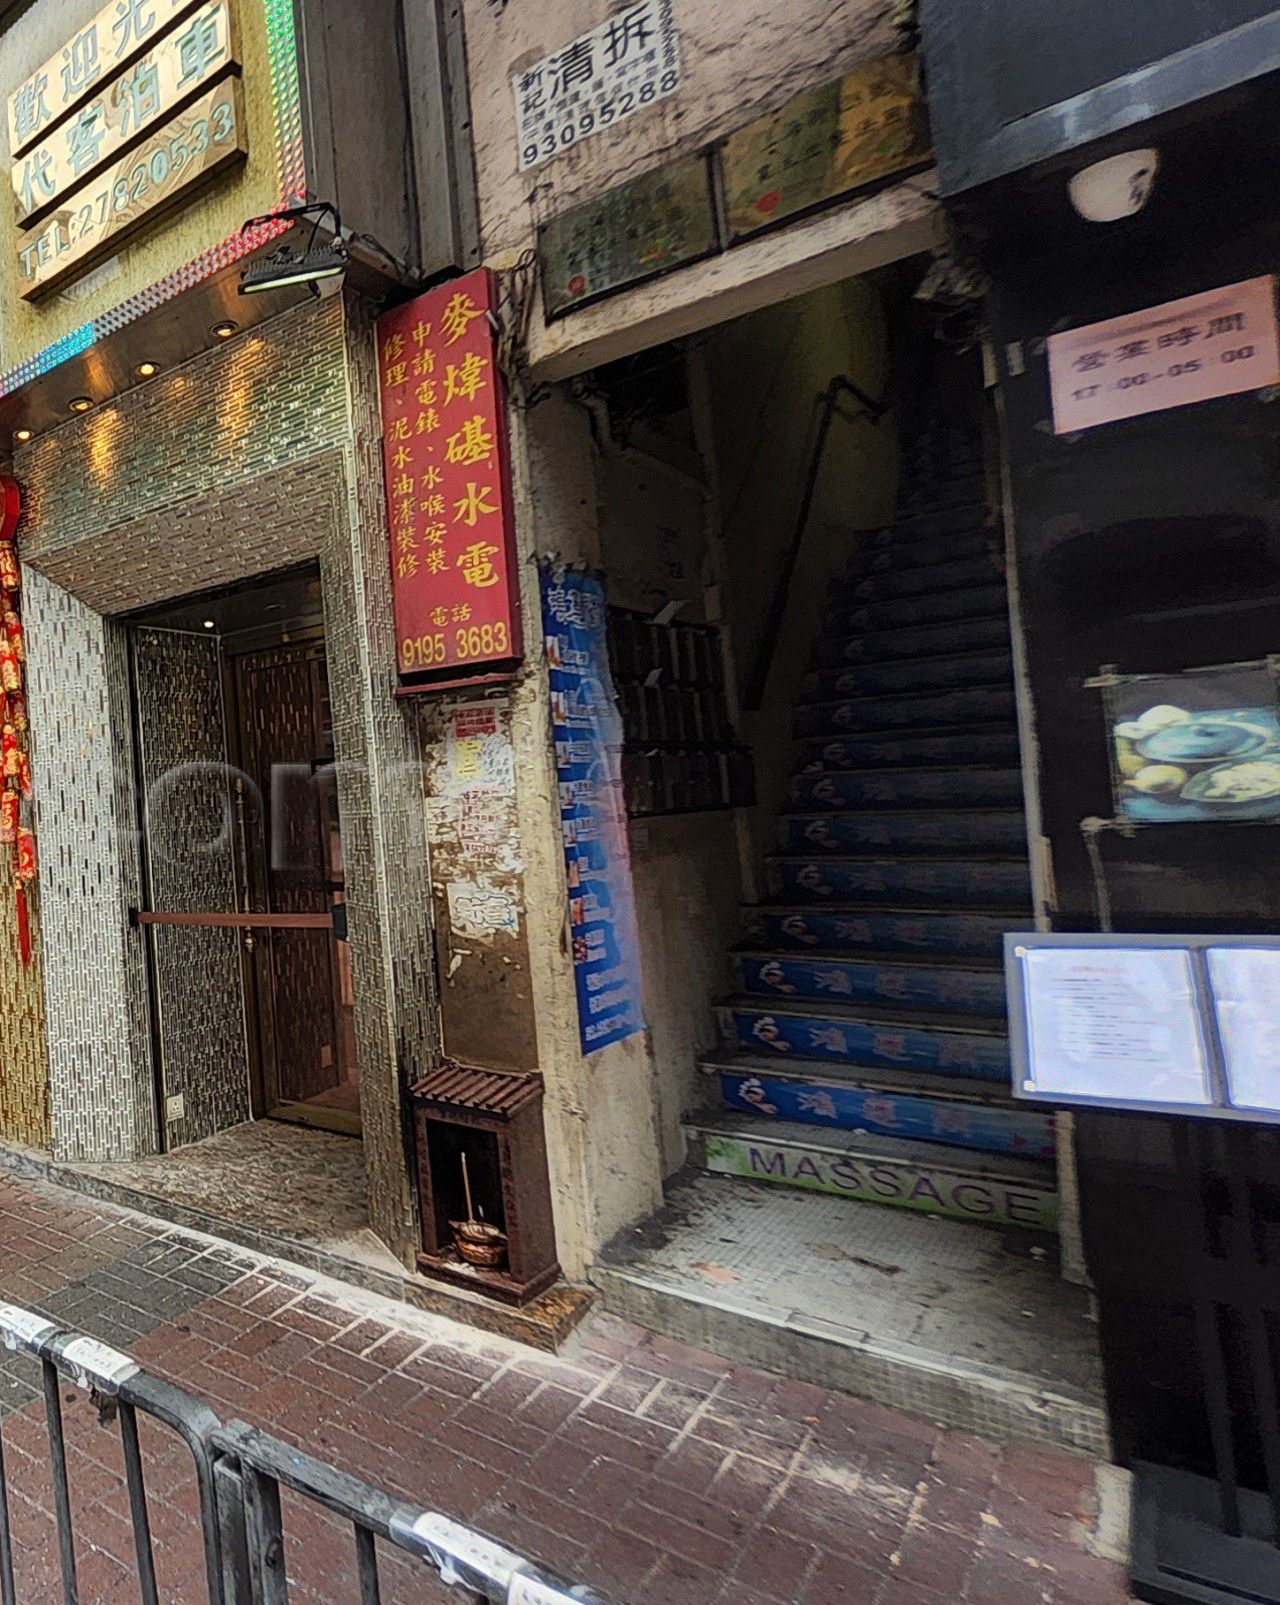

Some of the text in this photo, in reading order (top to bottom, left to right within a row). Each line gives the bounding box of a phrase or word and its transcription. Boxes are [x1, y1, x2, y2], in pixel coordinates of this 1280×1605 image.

[13, 0, 200, 145] 歡迎光
[518, 67, 548, 114] 新記
[548, 1, 654, 100] 清拆
[19, 3, 225, 215] 代客泊車
[523, 70, 678, 166] 93095288
[19, 101, 234, 279] TEL:27820533
[401, 621, 508, 668] 9195 3683
[429, 602, 472, 628] 電話
[748, 1146, 1043, 1226] MASSAGE
